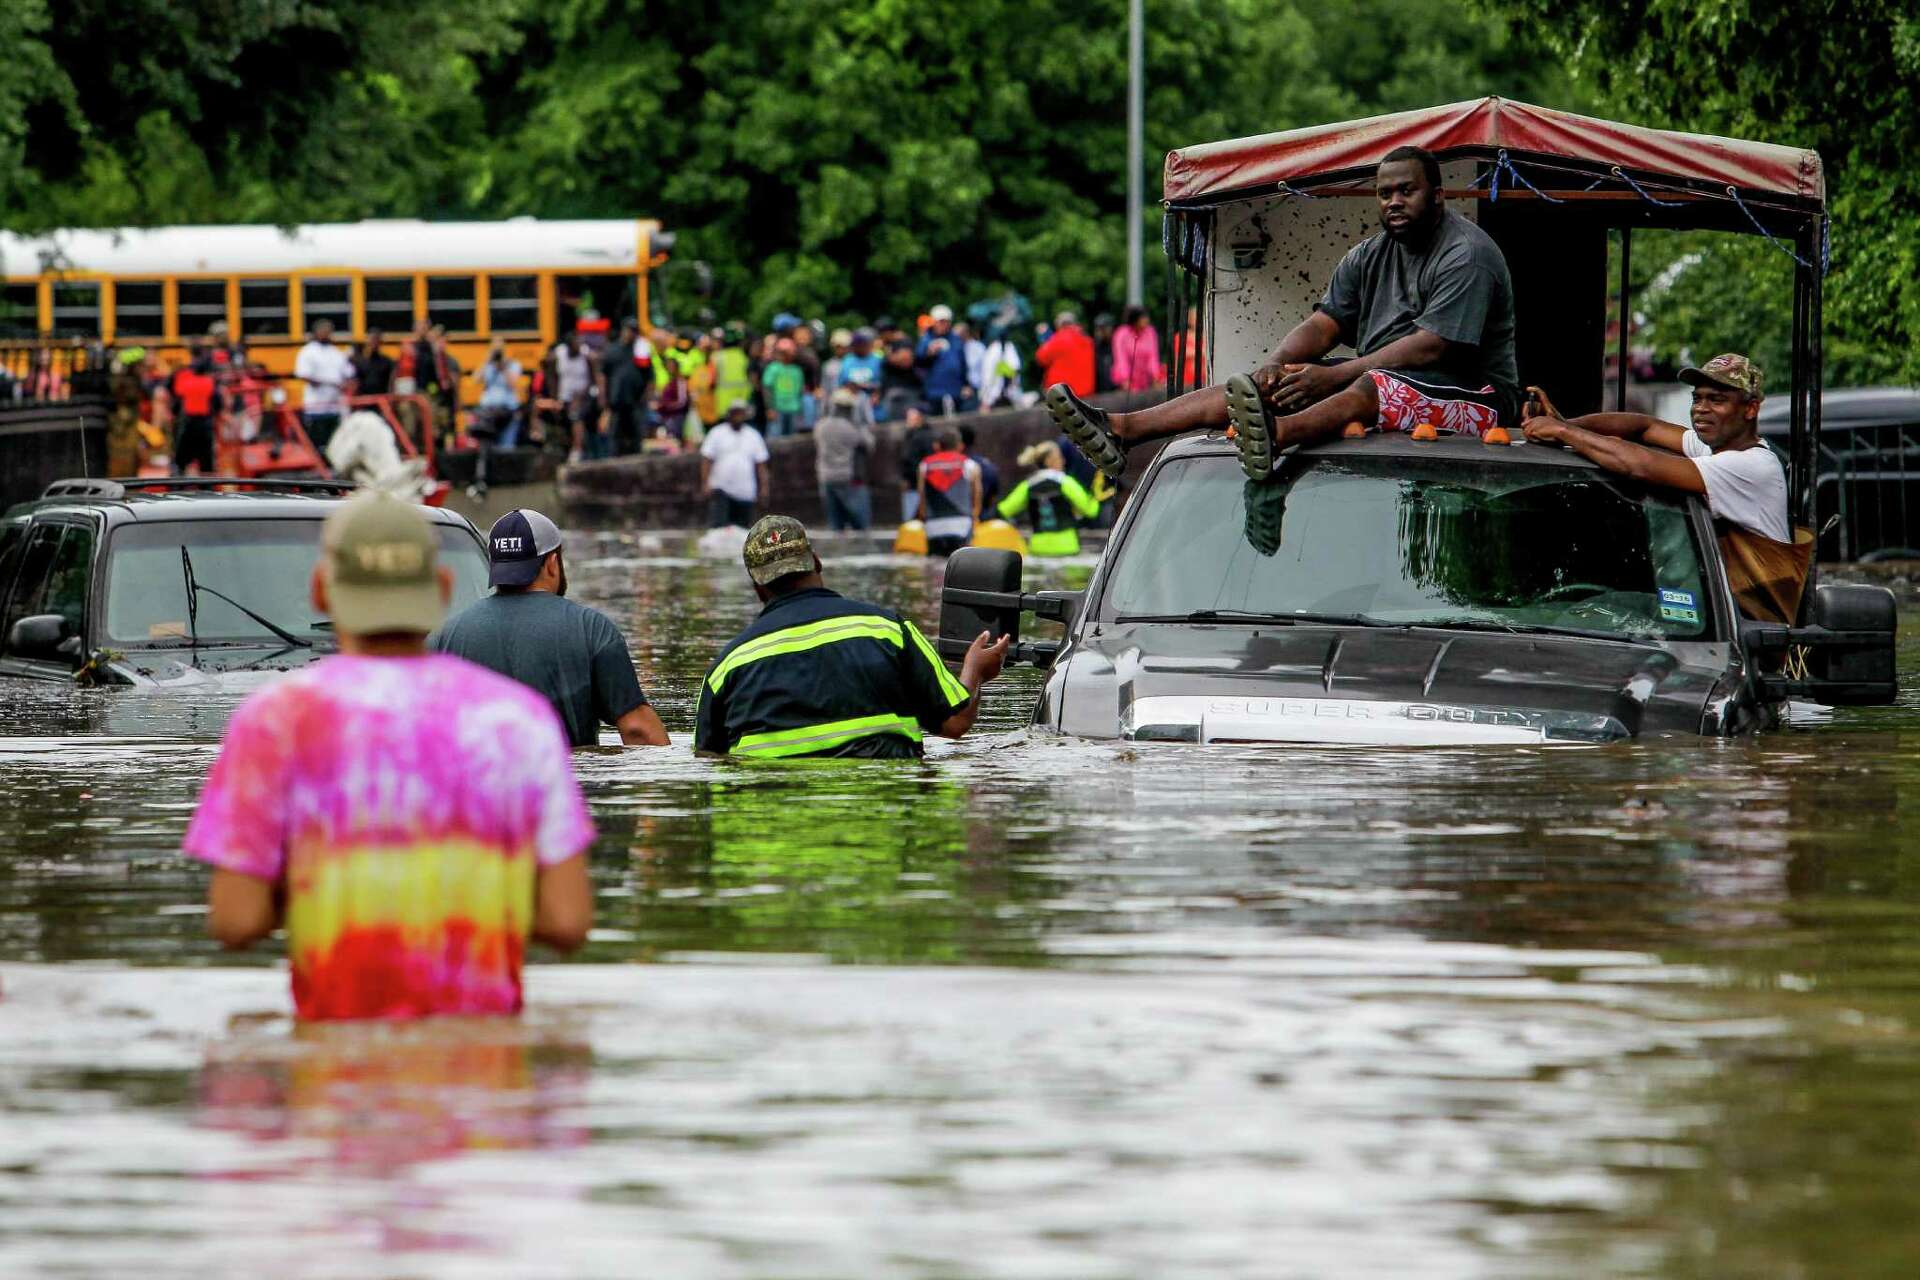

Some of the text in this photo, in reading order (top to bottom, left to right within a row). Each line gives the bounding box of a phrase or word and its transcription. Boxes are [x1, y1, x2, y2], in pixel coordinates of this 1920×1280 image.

[494, 537, 522, 549] YETI
[1208, 701, 1542, 726] SUPER DUTY
